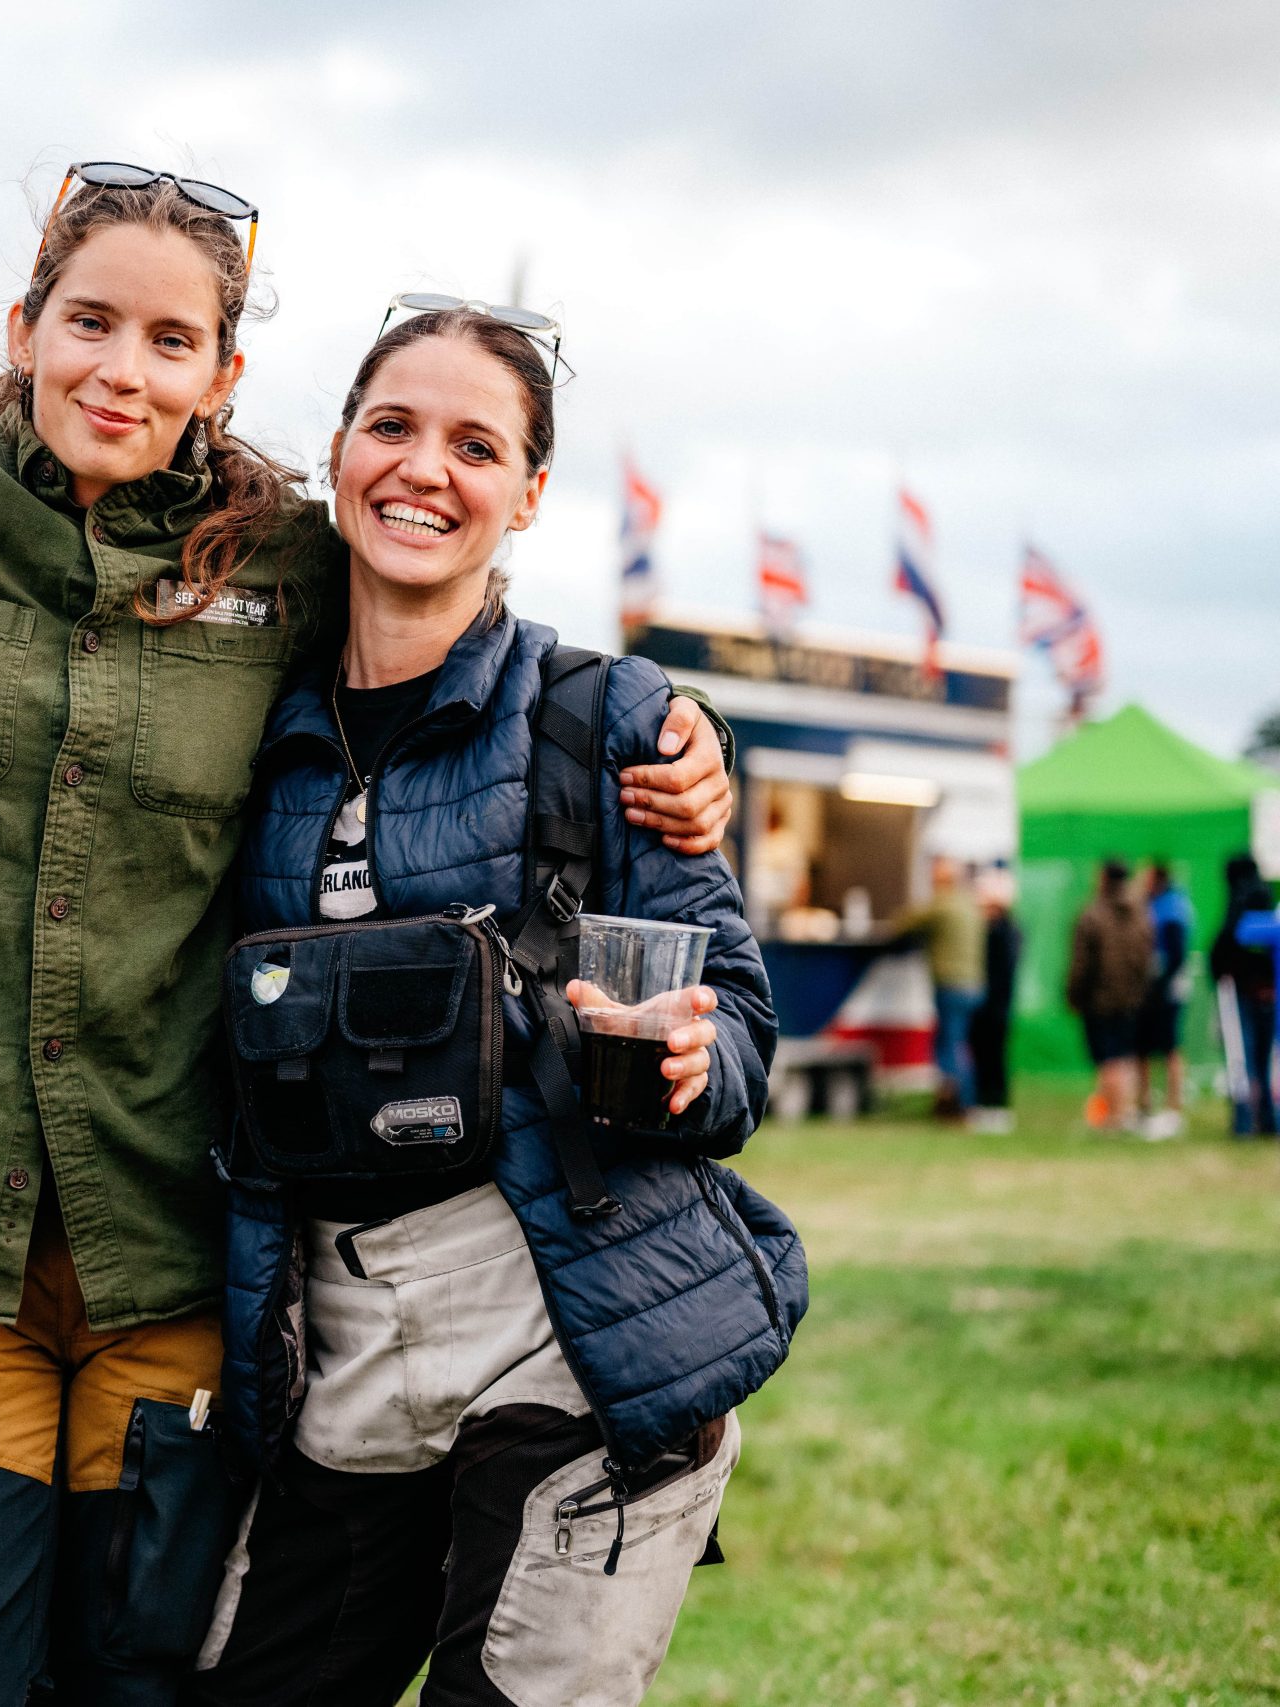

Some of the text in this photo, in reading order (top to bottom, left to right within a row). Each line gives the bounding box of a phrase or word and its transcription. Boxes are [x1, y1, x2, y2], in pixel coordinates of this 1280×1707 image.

[175, 592, 195, 605] SEE
[219, 596, 245, 612] NEXT
[245, 600, 267, 617] YEAR
[387, 1104, 456, 1120] MOSKO
[433, 1116, 457, 1124] MOTO
